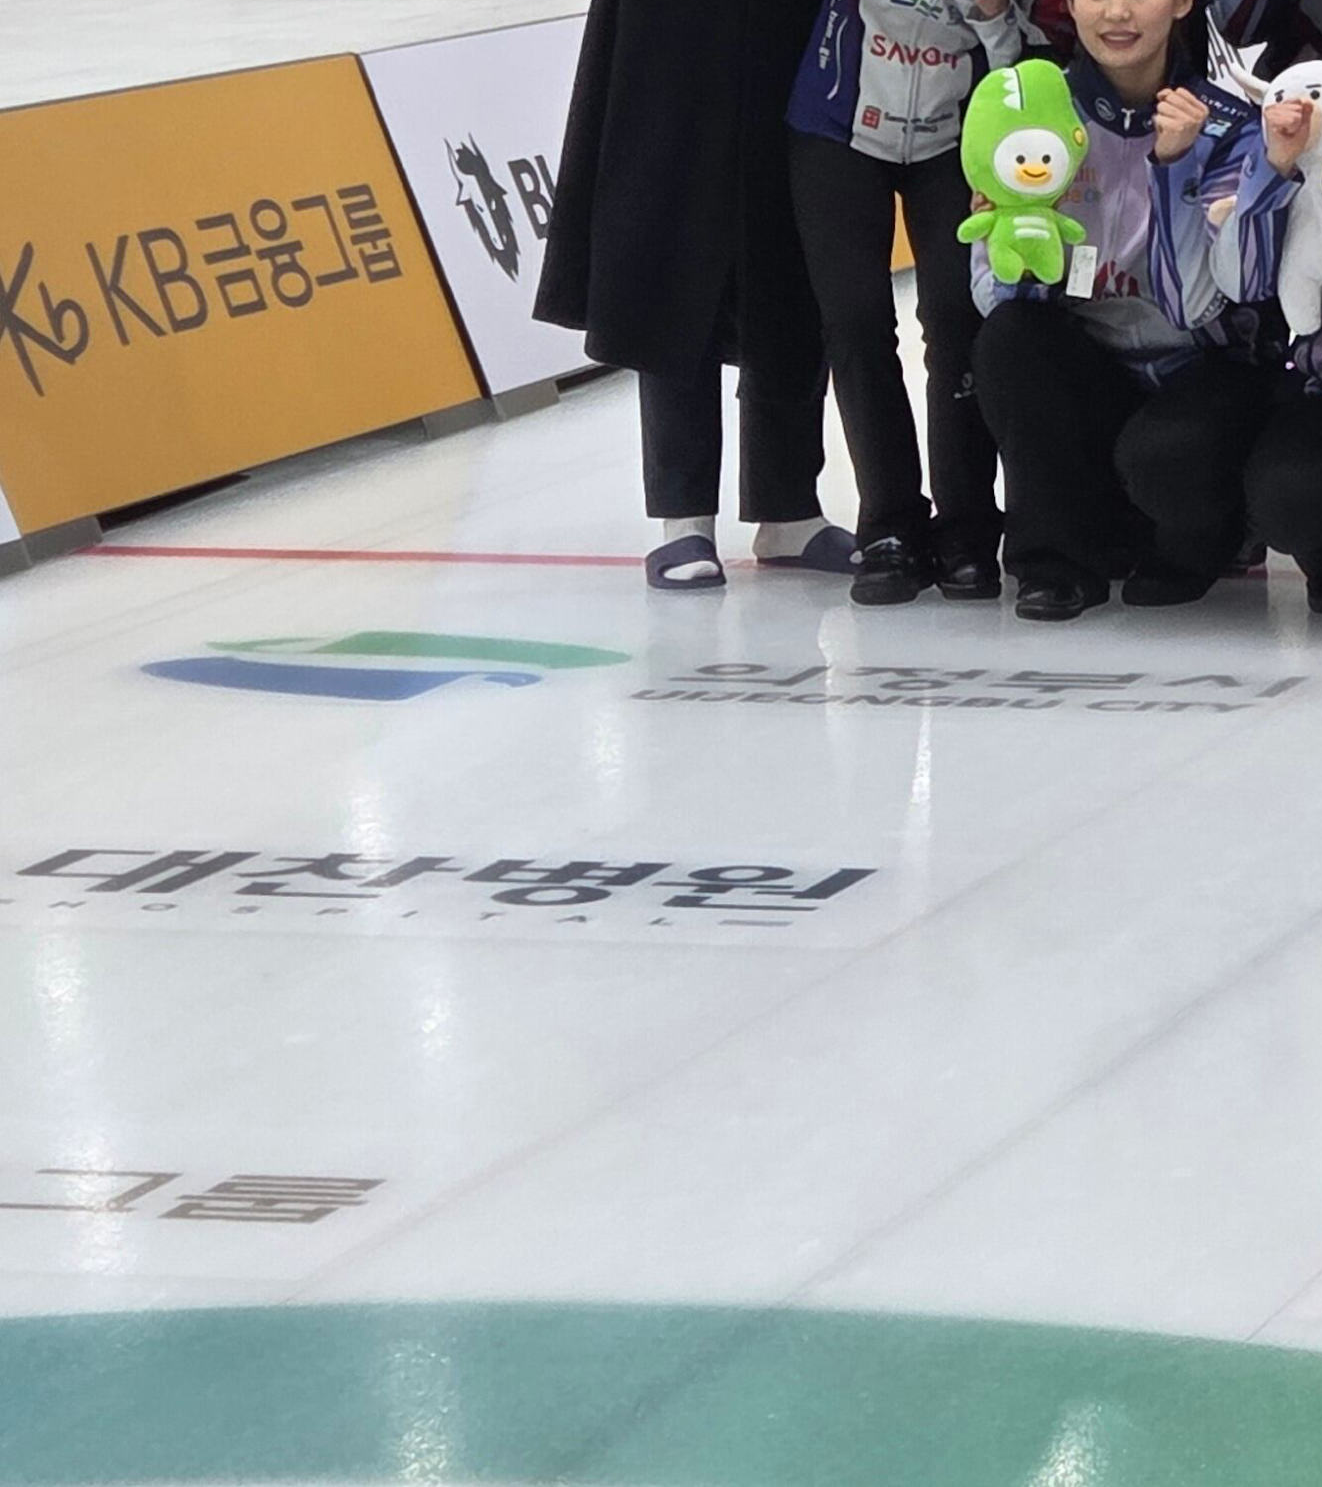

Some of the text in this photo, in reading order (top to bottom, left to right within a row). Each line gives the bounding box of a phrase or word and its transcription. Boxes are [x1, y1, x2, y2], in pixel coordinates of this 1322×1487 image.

[667, 662, 1309, 699] 의정부시
[1084, 698, 1258, 714] CITY
[14, 848, 881, 912] 대찬병원
